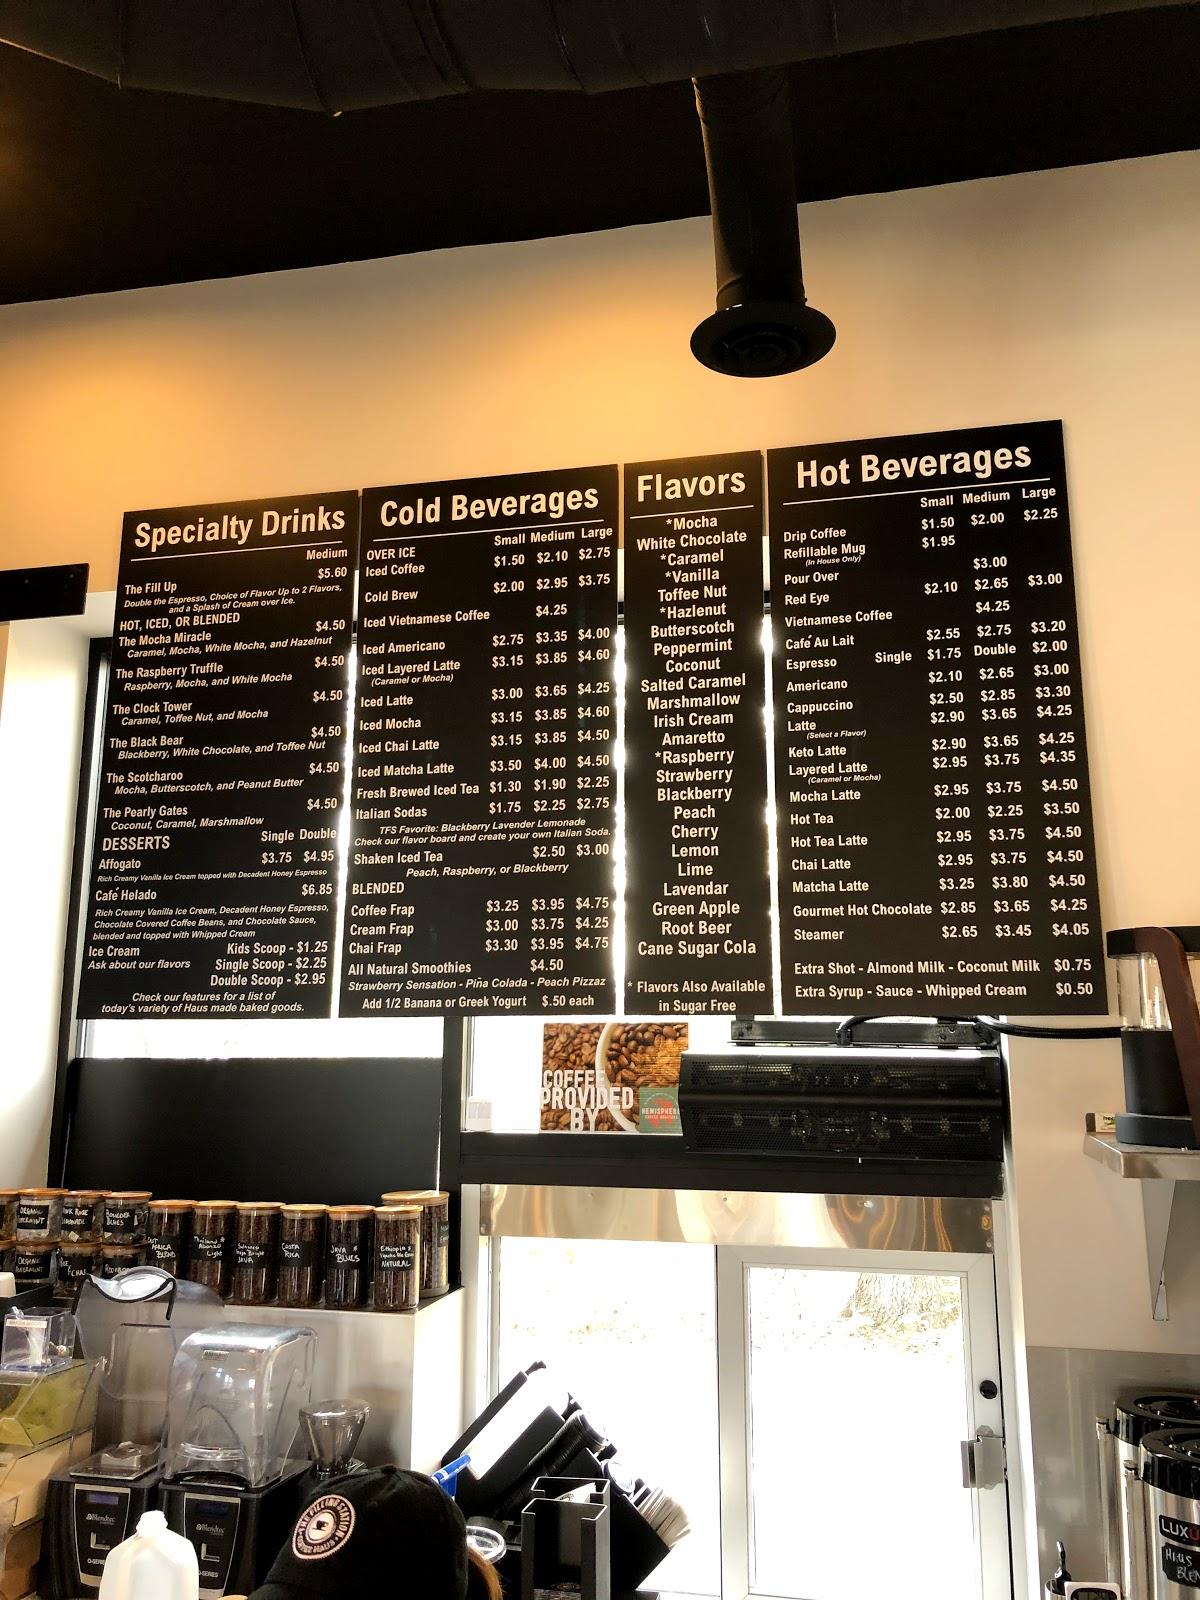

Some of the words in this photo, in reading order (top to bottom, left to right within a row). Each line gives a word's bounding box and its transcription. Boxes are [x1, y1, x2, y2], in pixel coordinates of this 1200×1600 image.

[797, 457, 850, 489] Hot
[860, 445, 1032, 482] Beverages
[637, 472, 746, 502] Flavors
[380, 496, 441, 527] Cold
[451, 487, 599, 521] Beverages
[920, 494, 954, 508] Small
[962, 491, 1010, 504] Medium
[1021, 487, 1056, 500] Large
[134, 514, 253, 553] Specialty
[261, 505, 345, 536] Drinks
[783, 530, 807, 543] Drip
[809, 527, 847, 540] Coffee
[921, 516, 955, 531] $1.50
[970, 511, 1005, 527] $2.00
[1023, 507, 1058, 522] $2.25
[493, 532, 526, 546] Small
[530, 530, 575, 543] Medium
[581, 527, 613, 540] Large
[636, 536, 676, 551] White
[679, 530, 747, 547] Chocolate
[306, 547, 348, 560] Medium
[366, 548, 396, 561] OVER
[398, 546, 416, 558] ICE
[805, 559, 815, 567] (In
[816, 557, 840, 565] House
[841, 554, 862, 563] Only)
[124, 584, 143, 595] The
[144, 581, 161, 593] Fill
[163, 581, 177, 594] Up
[317, 566, 347, 580] $5.60
[168, 604, 185, 614] and
[192, 602, 220, 613] Splash
[221, 600, 232, 609] of
[232, 600, 259, 609] Cream
[260, 598, 280, 606] over
[280, 596, 295, 605] Ice.
[784, 614, 852, 627] Vietnamese
[855, 609, 893, 622] Coffee
[975, 599, 1010, 614] $4.25
[119, 619, 142, 632] HOT,
[145, 617, 172, 630] ICED,
[175, 615, 190, 627] OR
[192, 612, 240, 626] BLENDED
[650, 619, 734, 638] Butterscotch
[653, 637, 732, 658] Peppermint
[786, 658, 837, 671] Espresso
[874, 650, 912, 665] Single
[926, 647, 962, 661] $1.75
[973, 642, 1017, 656] Double
[1032, 639, 1068, 654] $2.00
[123, 681, 173, 692] Raspberry,
[175, 677, 209, 688] Mocha,
[210, 675, 230, 686] and
[231, 674, 259, 684] White
[260, 672, 292, 683] Mocha
[371, 675, 410, 687] (Caramel
[422, 673, 454, 683] Mocha)
[640, 676, 684, 693] Salted
[688, 672, 746, 690] Caramel
[106, 772, 125, 784] The
[127, 770, 183, 783] Scotcharoo
[308, 761, 340, 775] $4.50
[357, 765, 381, 777] Iced
[383, 763, 423, 776] Matcha
[426, 762, 454, 774] Latte
[489, 759, 522, 773] $3.50
[533, 756, 566, 771] $4.00
[577, 754, 610, 769] $4.50
[379, 825, 397, 835] TFS
[398, 824, 439, 834] Favorite:
[440, 822, 491, 832] Blackberry
[492, 819, 536, 830] Lavender
[536, 817, 586, 828] Lemonade
[102, 835, 170, 851] DESSERTS
[260, 829, 295, 844] Single
[299, 827, 337, 840] Double
[113, 874, 139, 883] Creamy
[140, 873, 162, 881] Vanilla
[197, 871, 222, 881] topped
[237, 870, 270, 878] Decadent
[270, 869, 294, 878] Honey
[294, 869, 328, 877] Espresso
[95, 886, 119, 901] Café
[120, 888, 157, 900] Helado
[301, 883, 333, 896] $6.85
[351, 881, 405, 895] BLENDED
[663, 880, 729, 896] Lavendar
[792, 904, 845, 917] Gourmet
[847, 903, 869, 916] Hot
[871, 902, 932, 916] Chocolate
[940, 901, 976, 915] $2.85
[993, 899, 1030, 914] $3.65
[1050, 898, 1088, 912] $4.25
[793, 928, 844, 940] Steamer
[941, 925, 978, 939] $2.65
[994, 924, 1032, 938] $3.45
[1051, 922, 1090, 937] $4.05
[637, 940, 673, 955] Cane
[677, 940, 720, 958] Sugar
[723, 939, 756, 954] Cola
[361, 997, 382, 1009] Add
[385, 997, 401, 1009] 1/2
[403, 997, 442, 1008] Banana
[444, 998, 456, 1008] or
[458, 995, 489, 1007] Greek
[491, 995, 527, 1009] Yogurt
[541, 994, 566, 1007] $.50
[568, 994, 594, 1006] each
[658, 999, 670, 1011] in
[673, 999, 707, 1014] Sugar
[710, 999, 737, 1011] Free
[543, 1069, 606, 1088] COFFEE
[541, 1086, 634, 1110] PROVIDED
[570, 1107, 600, 1132] BY
[281, 1242, 300, 1250] COSTA
[284, 1249, 301, 1259] RICA
[330, 1245, 347, 1254] JAVA
[336, 1252, 360, 1263] BLUES
[381, 1259, 411, 1268] NATURAL
